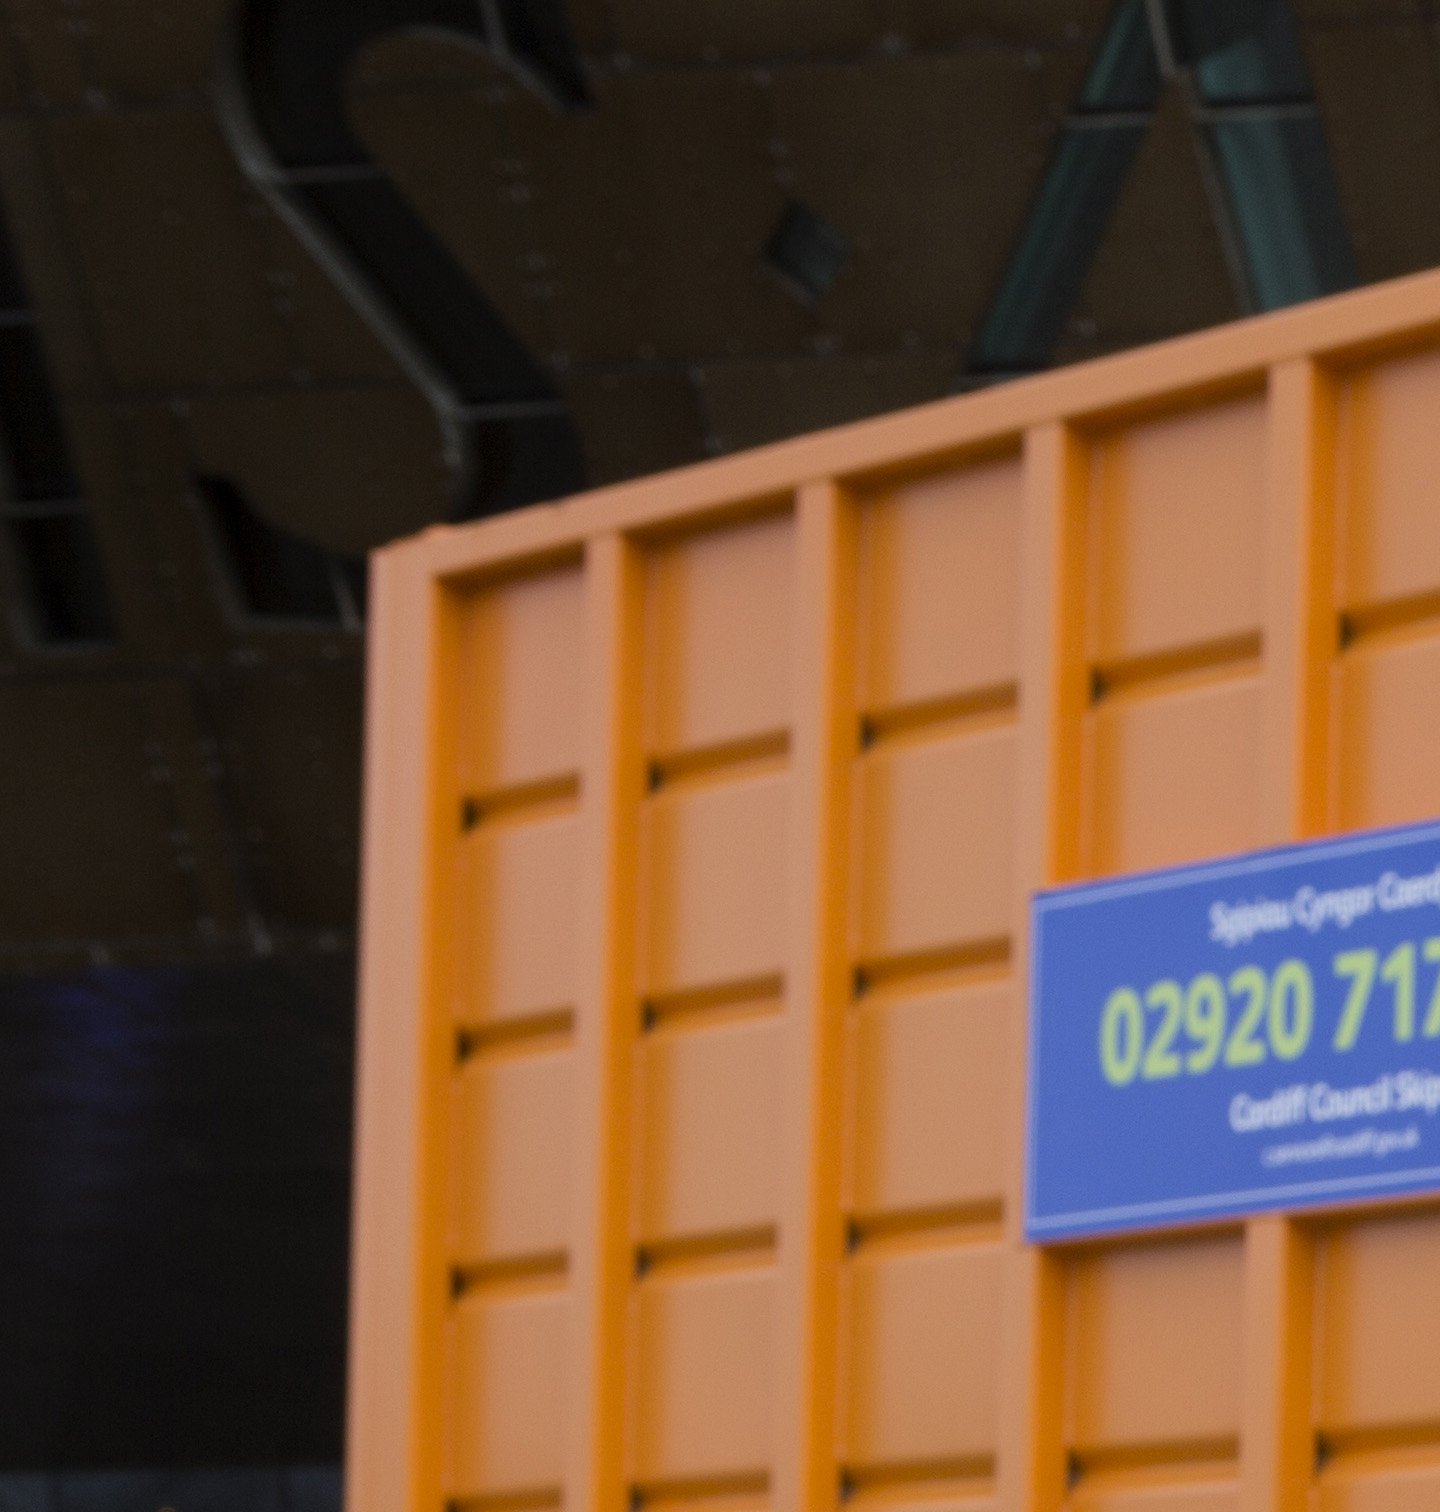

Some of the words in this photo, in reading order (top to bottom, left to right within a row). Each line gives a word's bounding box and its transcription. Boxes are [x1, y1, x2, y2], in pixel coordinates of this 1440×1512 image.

[1101, 959, 1314, 1087] 02920
[1229, 1083, 1307, 1133] Cardiff
[1308, 1072, 1393, 1123] Council
